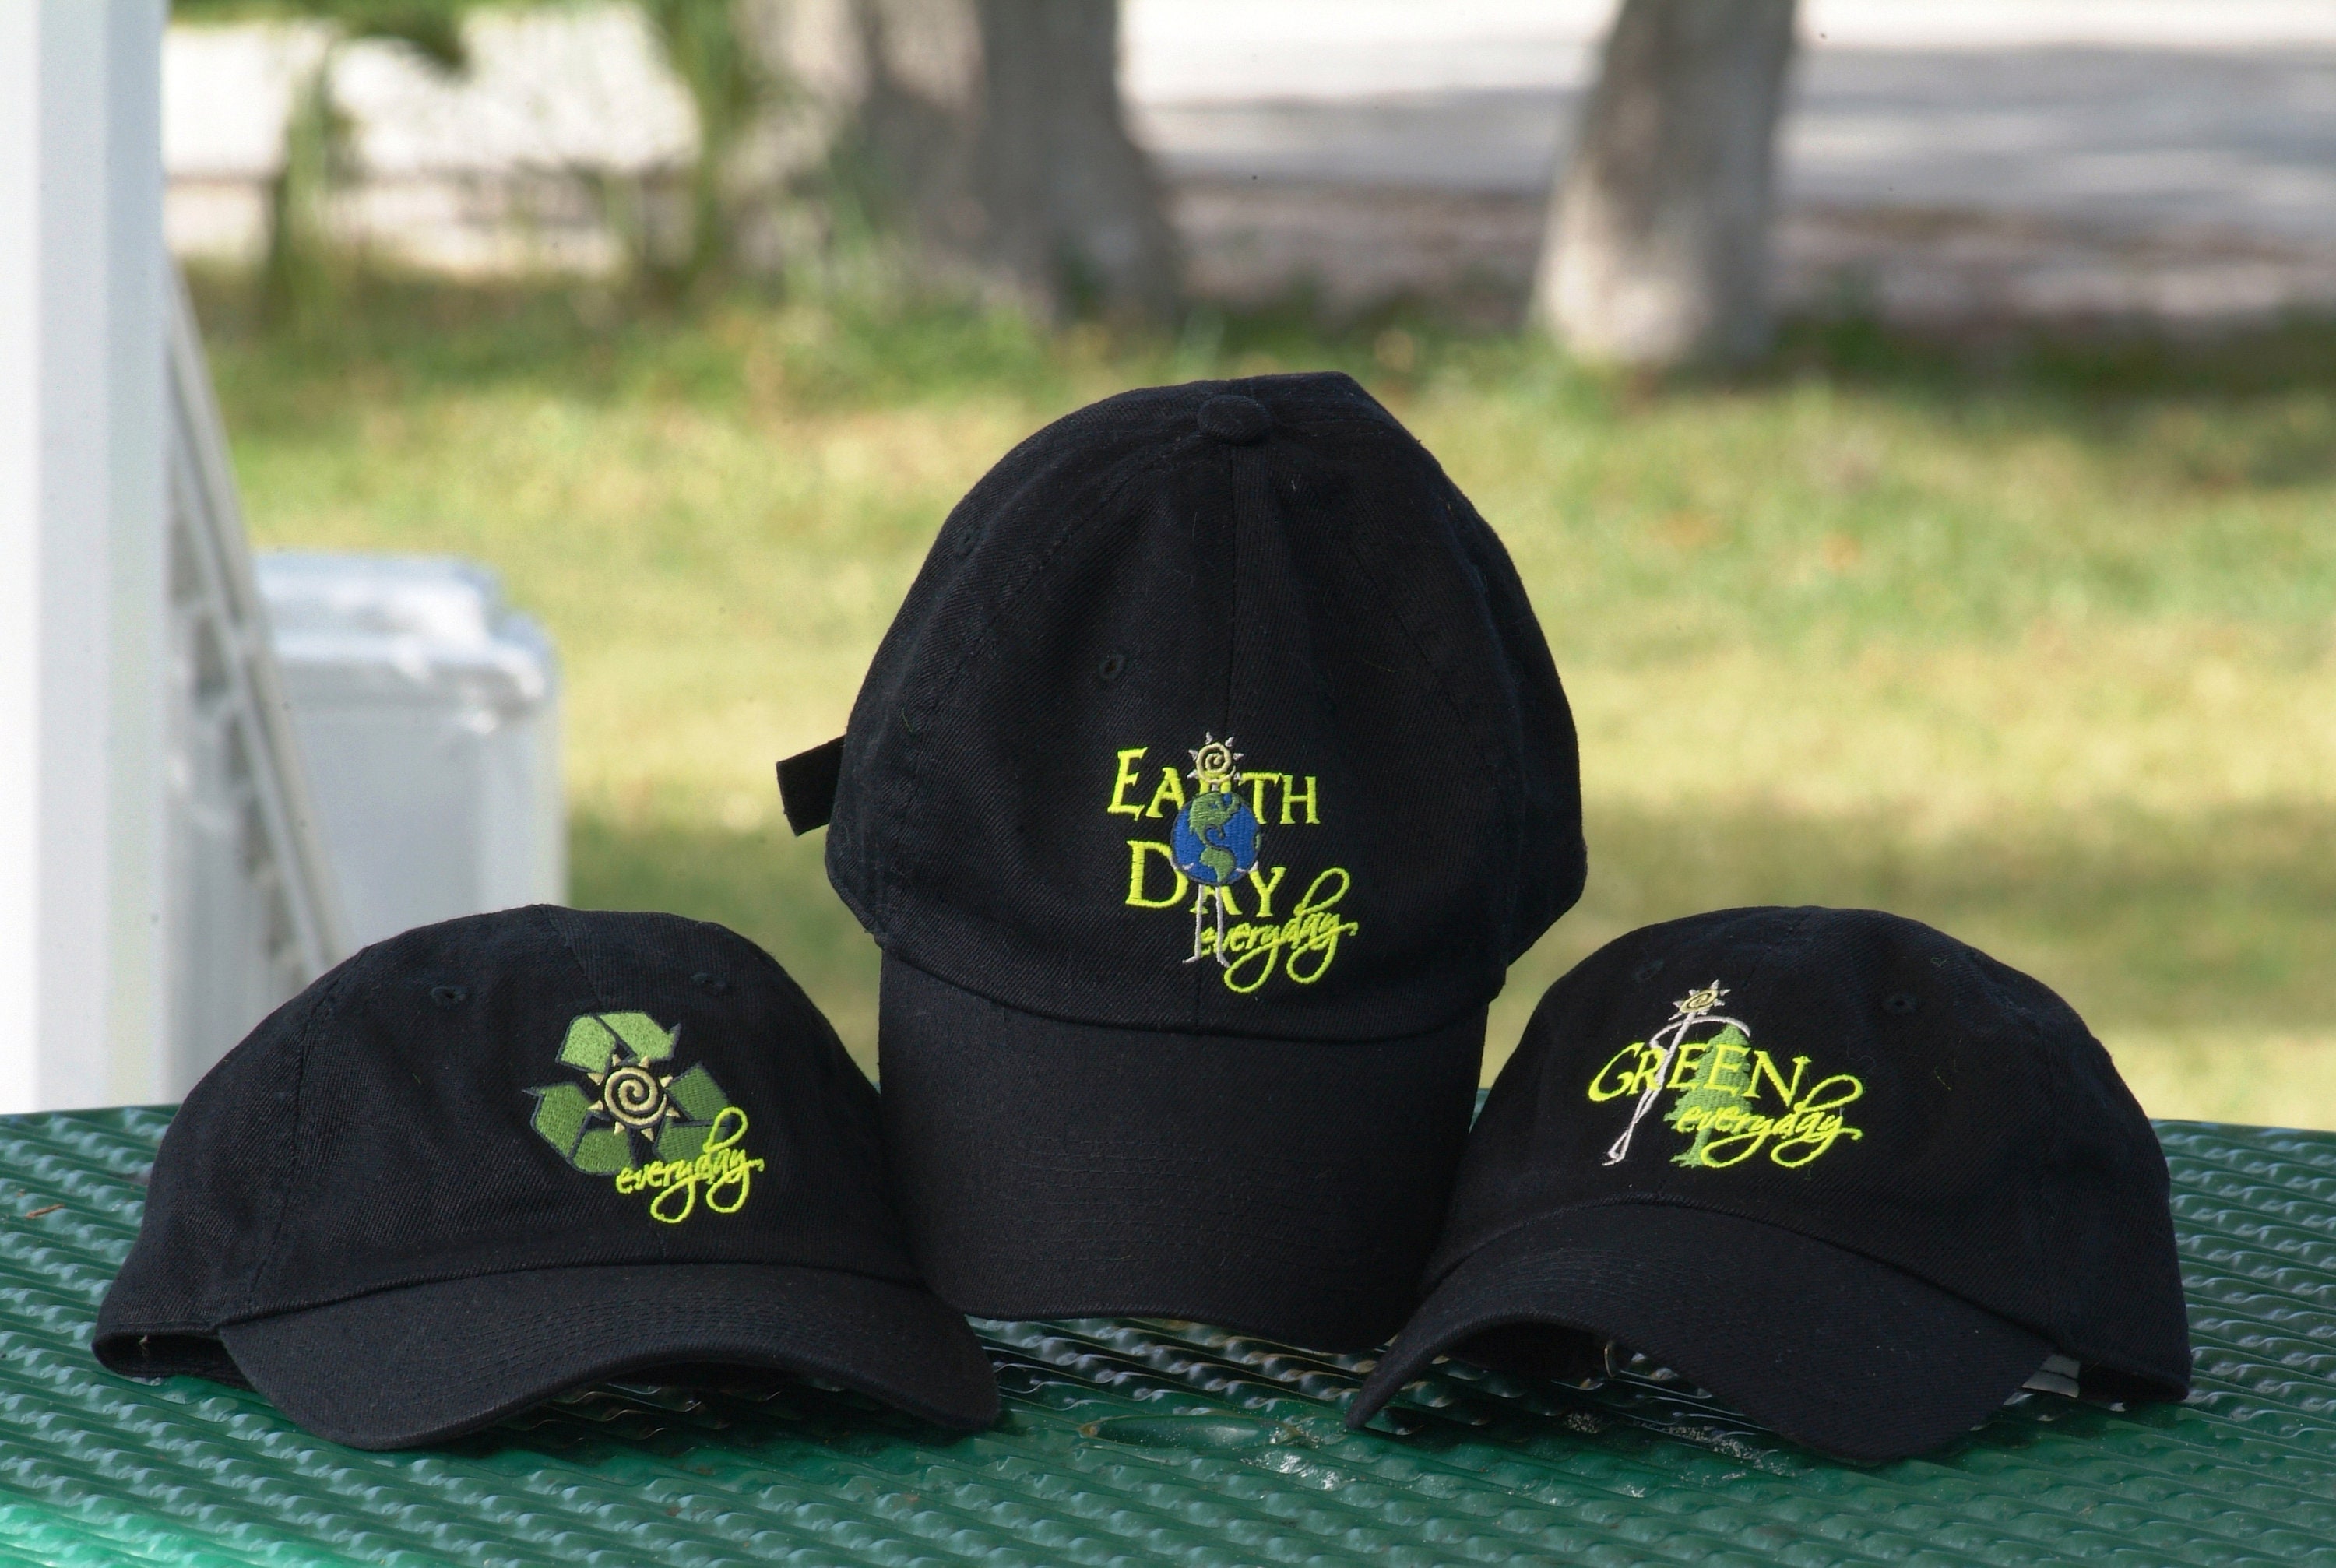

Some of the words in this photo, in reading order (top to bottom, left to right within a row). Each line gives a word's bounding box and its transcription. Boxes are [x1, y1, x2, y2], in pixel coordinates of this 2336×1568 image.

[1588, 1042, 1812, 1106] GREEN
[1677, 1074, 1864, 1168] everyday
[615, 1106, 765, 1223] everyday
